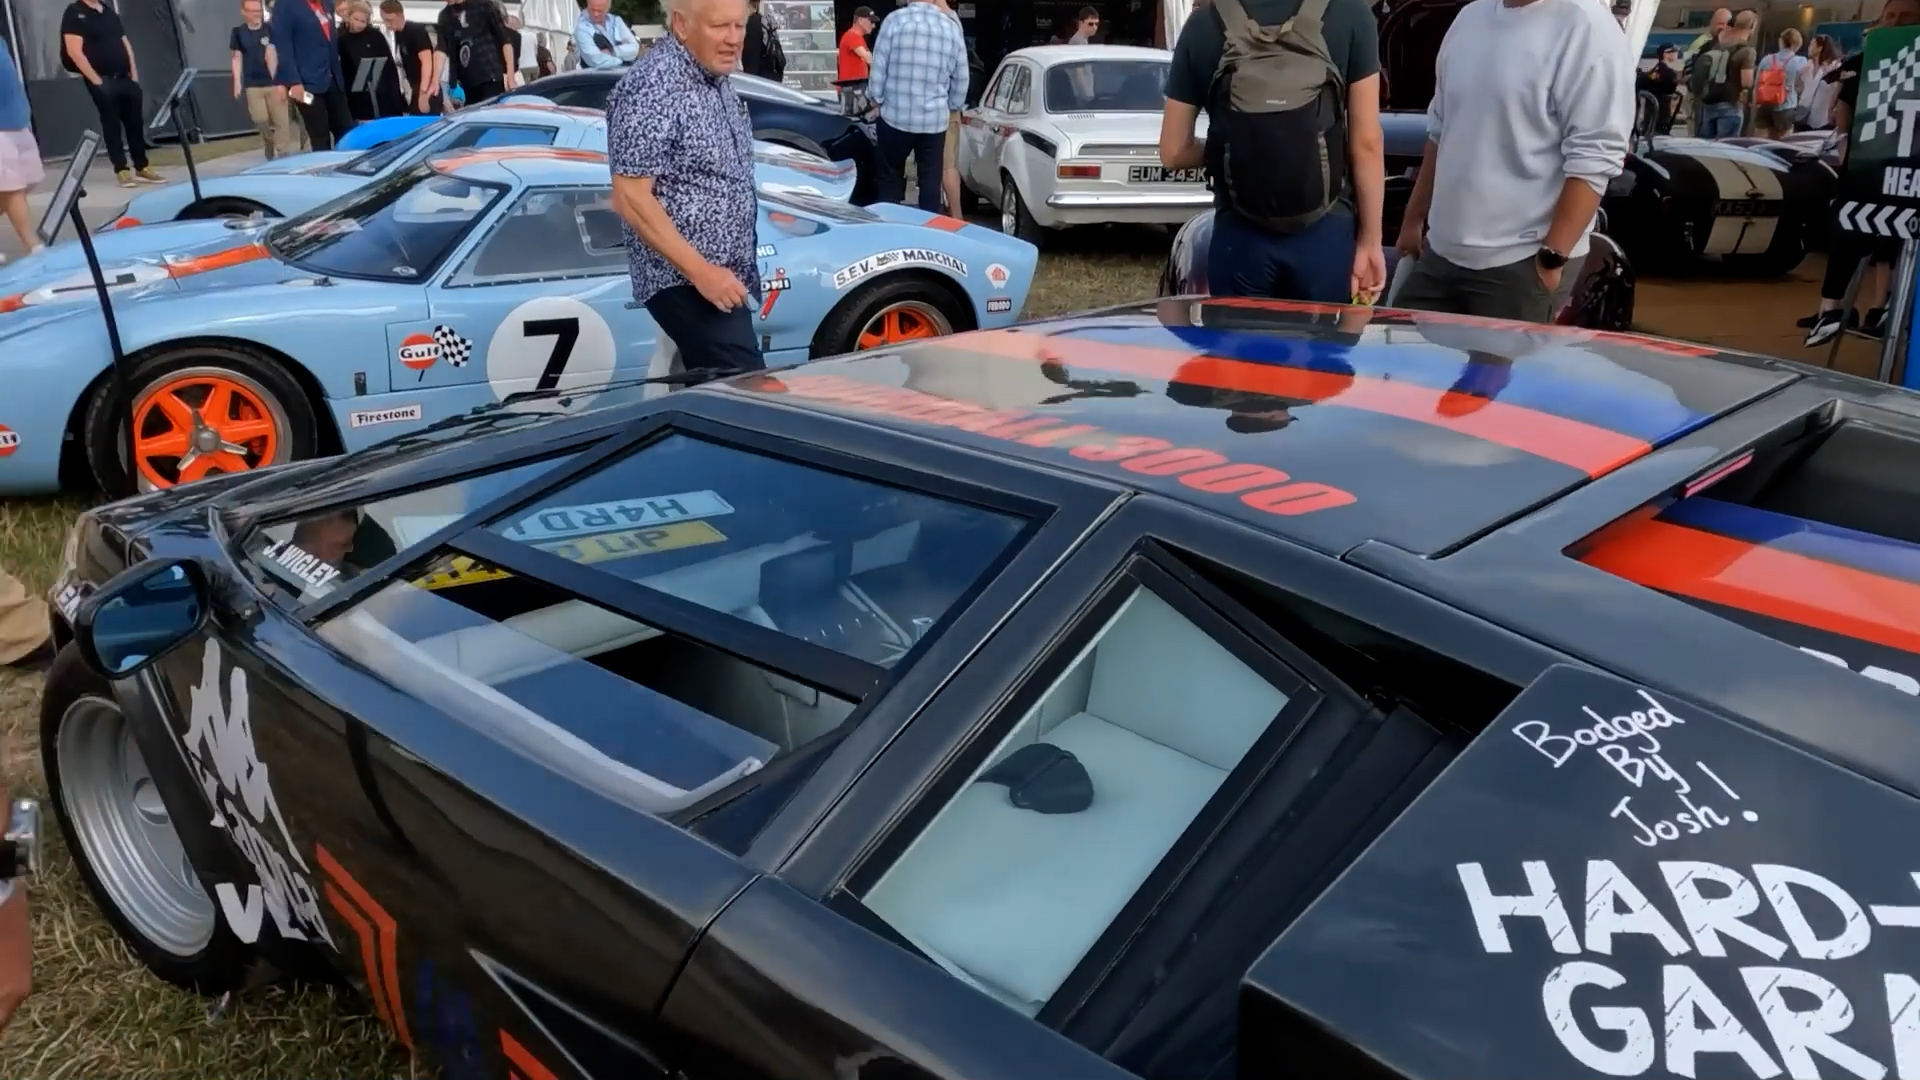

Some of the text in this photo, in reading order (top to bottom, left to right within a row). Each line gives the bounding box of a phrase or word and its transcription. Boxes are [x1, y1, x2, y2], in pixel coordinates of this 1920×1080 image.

[1129, 167, 1162, 181] EUM
[902, 250, 966, 275] MARCHAL
[760, 279, 790, 292] ONI
[400, 346, 440, 358] Gulf
[523, 317, 579, 393] 7
[356, 409, 416, 424] Firestone
[275, 544, 341, 588] WIGLEY
[1511, 689, 1686, 768] Bodged
[1596, 743, 1691, 794] By
[1456, 859, 1920, 961] HARD-
